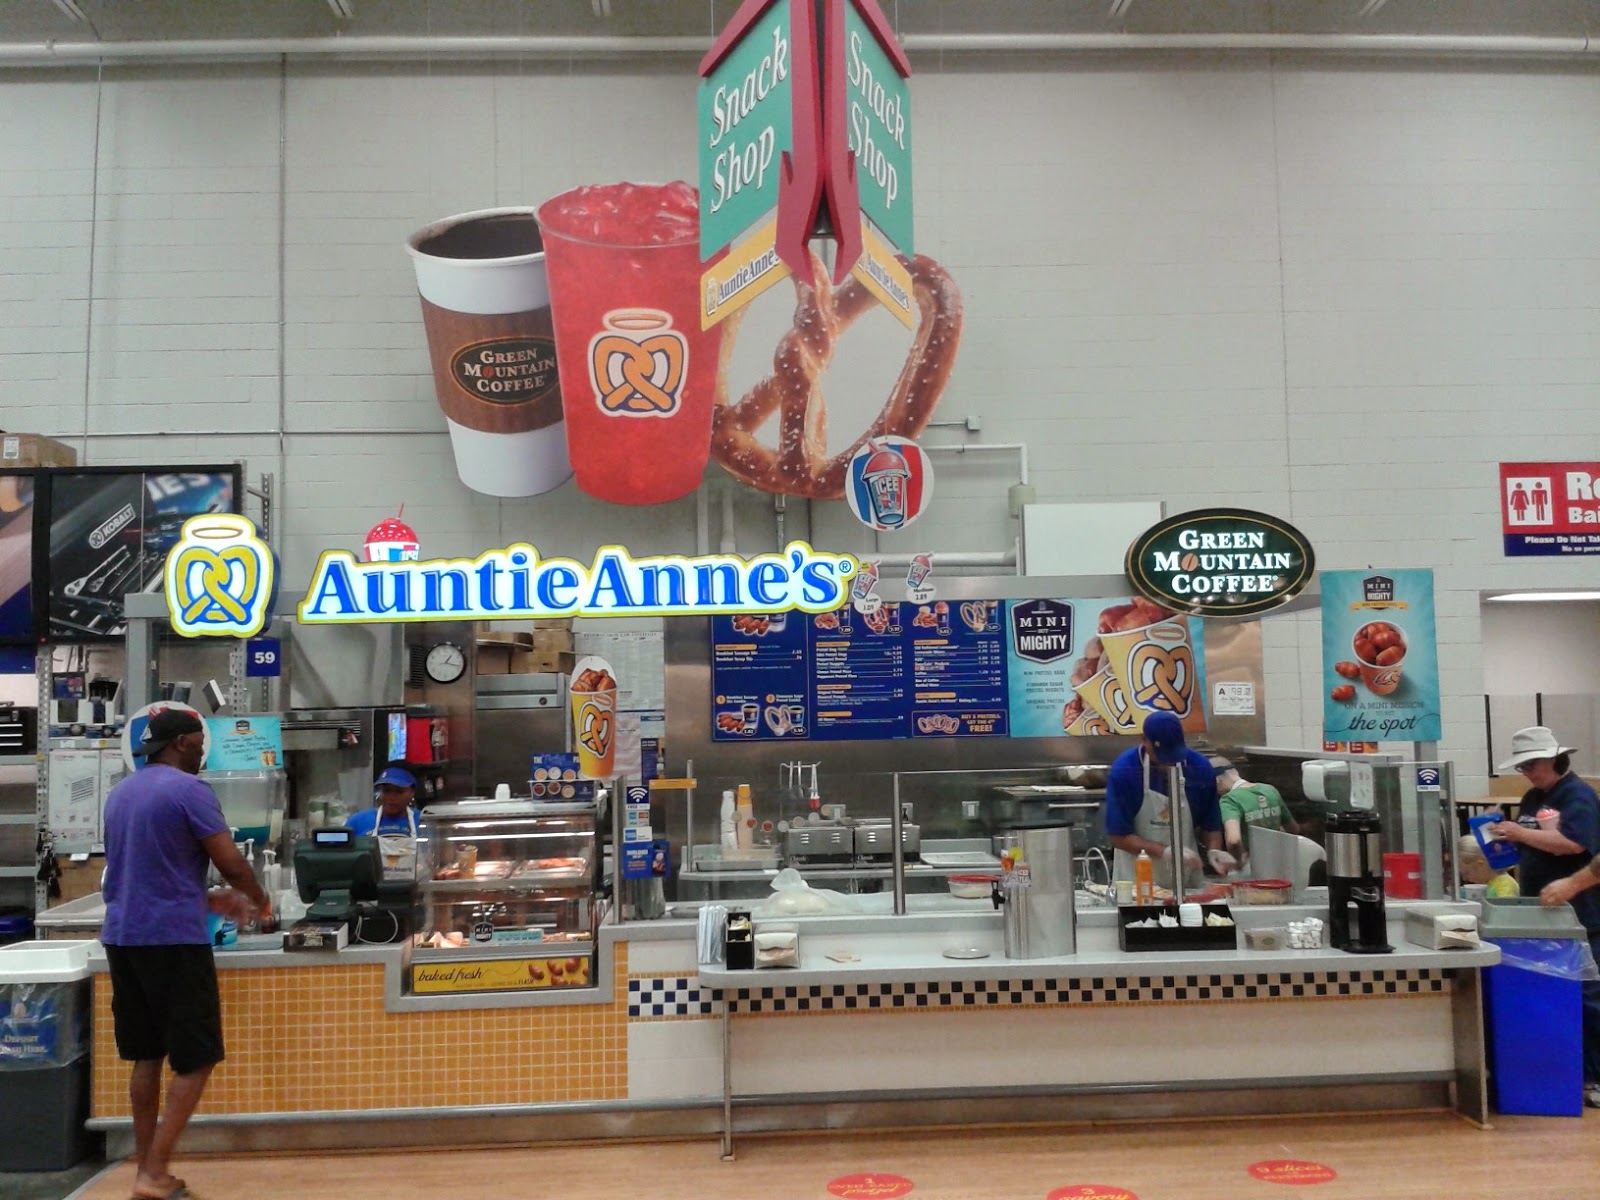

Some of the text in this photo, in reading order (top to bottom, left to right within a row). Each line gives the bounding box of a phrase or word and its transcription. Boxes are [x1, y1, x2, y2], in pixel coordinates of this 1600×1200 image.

[710, 25, 788, 148] Snack
[848, 30, 904, 151] Snack
[848, 101, 898, 209] Shop
[710, 125, 775, 214] Shop
[876, 476, 899, 493] ICEE
[102, 507, 133, 538] KOBALT
[1568, 506, 1600, 523] Ba
[1178, 530, 1264, 550] GREEN
[1571, 535, 1586, 543] Not
[1171, 575, 1274, 593] COFFEE
[1367, 592, 1391, 600] MIGHTY
[1019, 616, 1068, 628] MINI
[1020, 635, 1067, 651] MIGHTY
[254, 652, 276, 664] 59
[1218, 687, 1226, 696] A
[1368, 701, 1387, 709] MINI
[1391, 701, 1424, 709] MISSION
[1349, 712, 1416, 738] the spot
[418, 966, 482, 983] baked fresh
